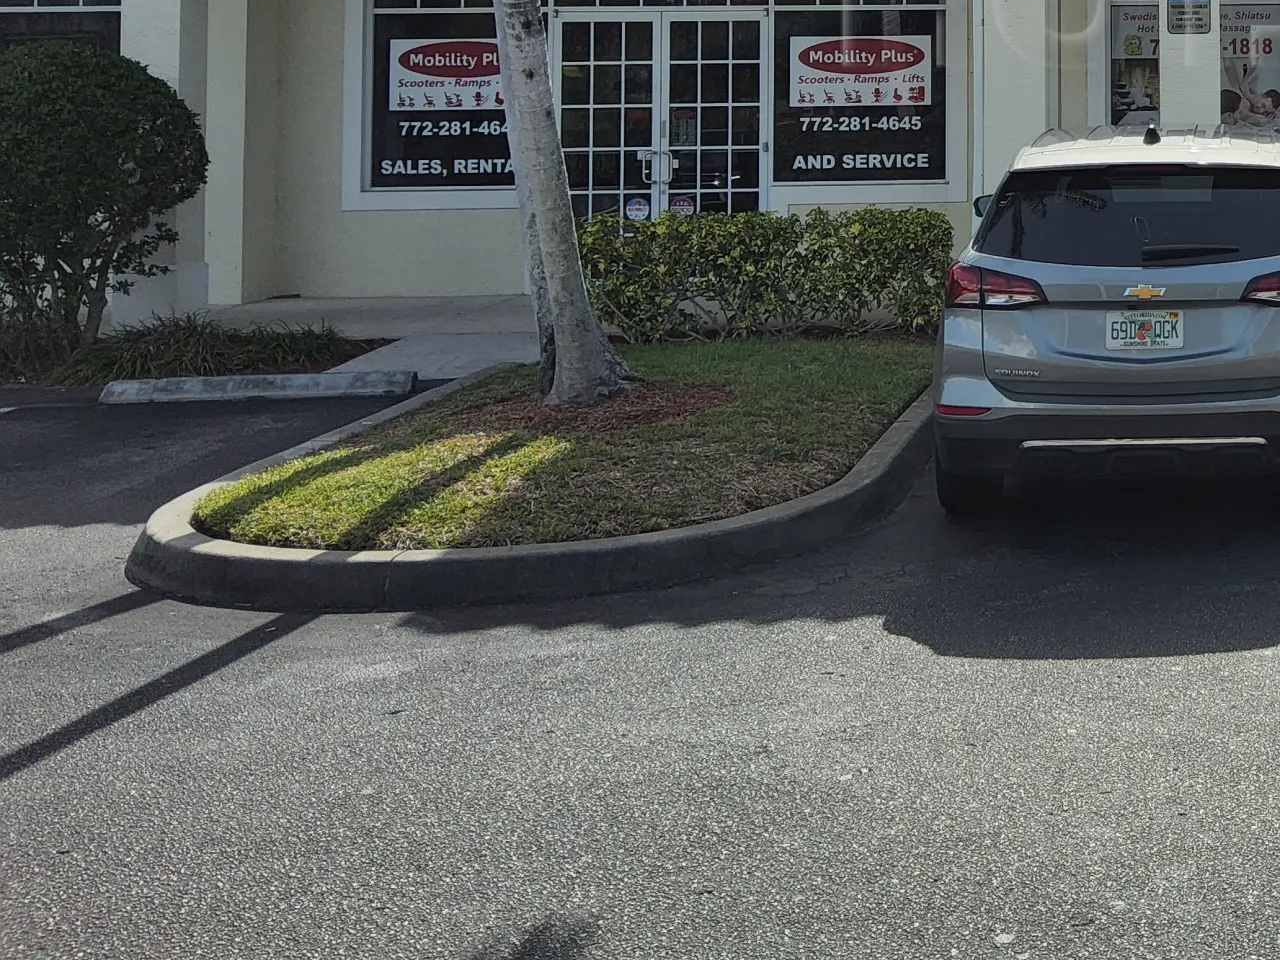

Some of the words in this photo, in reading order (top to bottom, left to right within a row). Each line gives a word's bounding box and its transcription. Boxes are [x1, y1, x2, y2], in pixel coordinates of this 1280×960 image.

[1122, 12, 1158, 22] Swedis
[1234, 11, 1272, 20] Shiatsu
[1137, 24, 1155, 33] Hot
[1220, 24, 1257, 34] assag
[409, 52, 478, 69] Mobility
[482, 52, 500, 66] Pl
[808, 49, 877, 67] Mobility
[397, 78, 445, 89] Scooters
[454, 78, 492, 90] Ramps
[797, 75, 845, 85] Scooters
[853, 74, 890, 86] Ramps
[902, 73, 925, 83] Lifts
[399, 120, 509, 136] 772-281-464
[799, 116, 922, 132] 772-281-4645
[380, 159, 448, 177] SALES,
[453, 158, 514, 174] RENTA
[792, 154, 836, 170] AND
[841, 153, 929, 169] SERVICE
